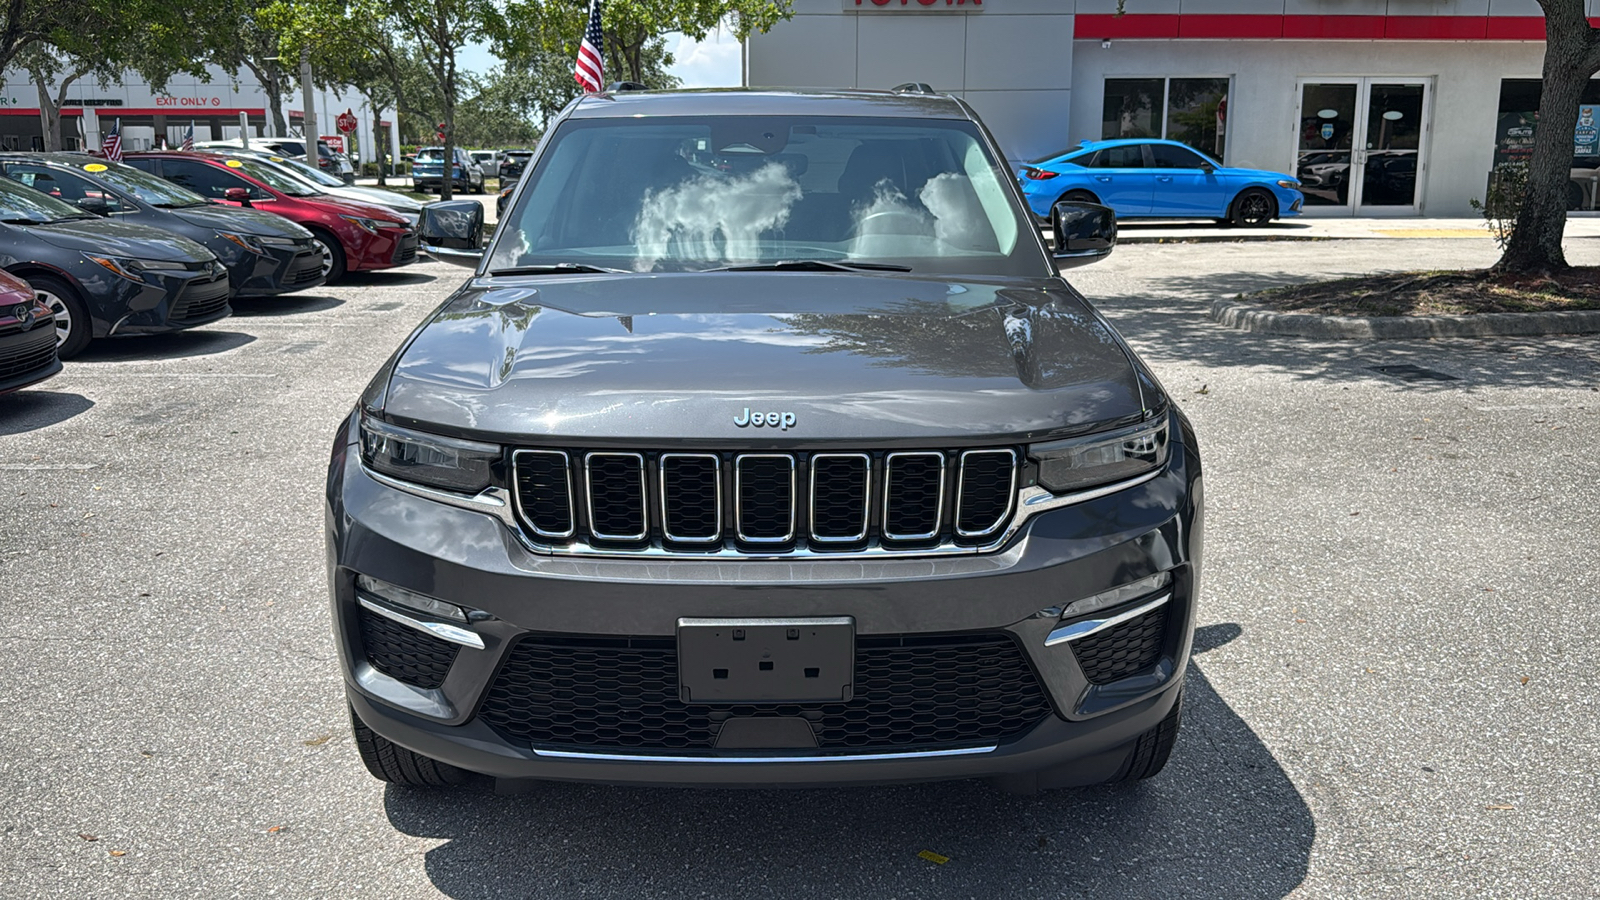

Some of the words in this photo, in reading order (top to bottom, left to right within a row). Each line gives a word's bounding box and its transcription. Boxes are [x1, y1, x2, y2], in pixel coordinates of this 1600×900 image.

[156, 97, 177, 106] EXIT
[180, 97, 207, 106] ONLY
[733, 407, 796, 430] Jeep
